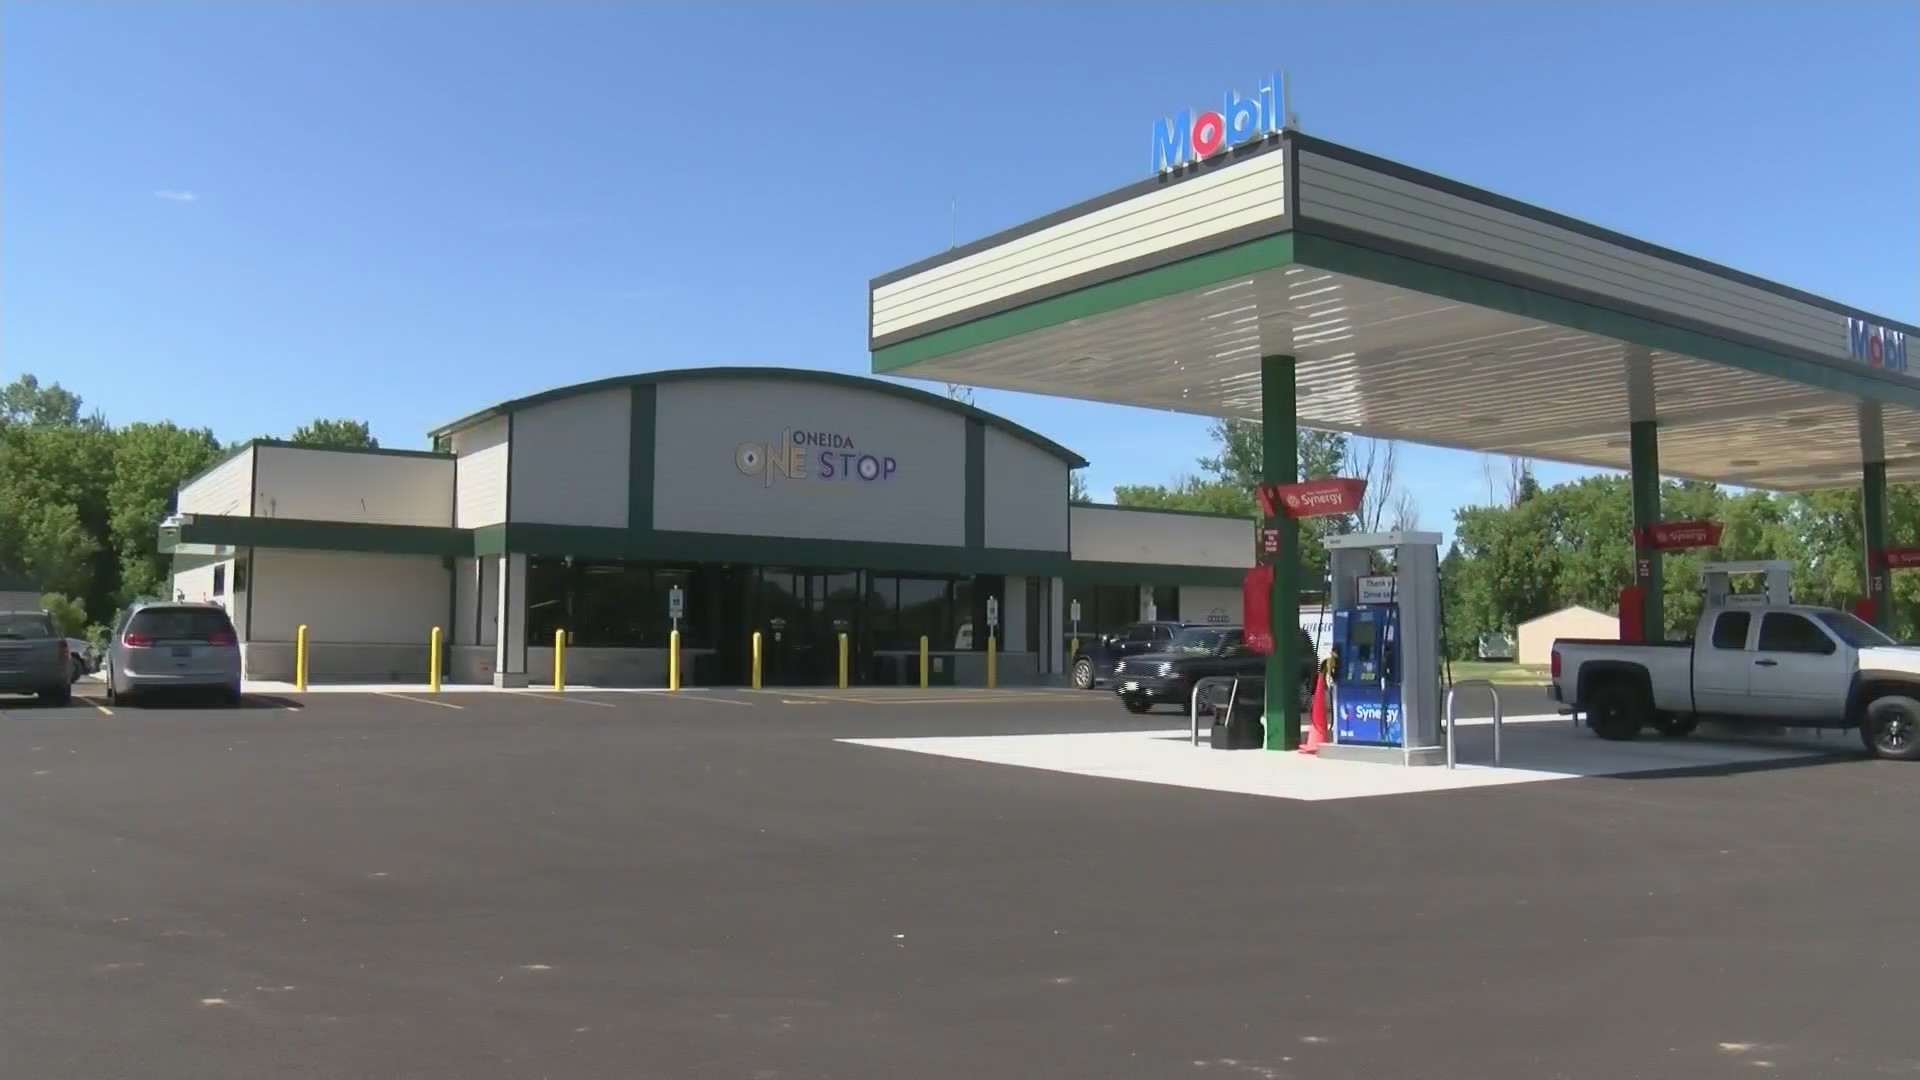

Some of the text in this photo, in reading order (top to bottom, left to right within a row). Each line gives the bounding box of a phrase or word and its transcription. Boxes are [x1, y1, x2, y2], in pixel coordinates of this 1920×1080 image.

[1151, 69, 1286, 174] Mobil
[1848, 317, 1907, 370] Mobil
[735, 427, 897, 488] ONE STOP
[793, 430, 854, 449] ONEIDA
[1300, 492, 1342, 507] Synergy
[1356, 705, 1399, 722] Synegy
